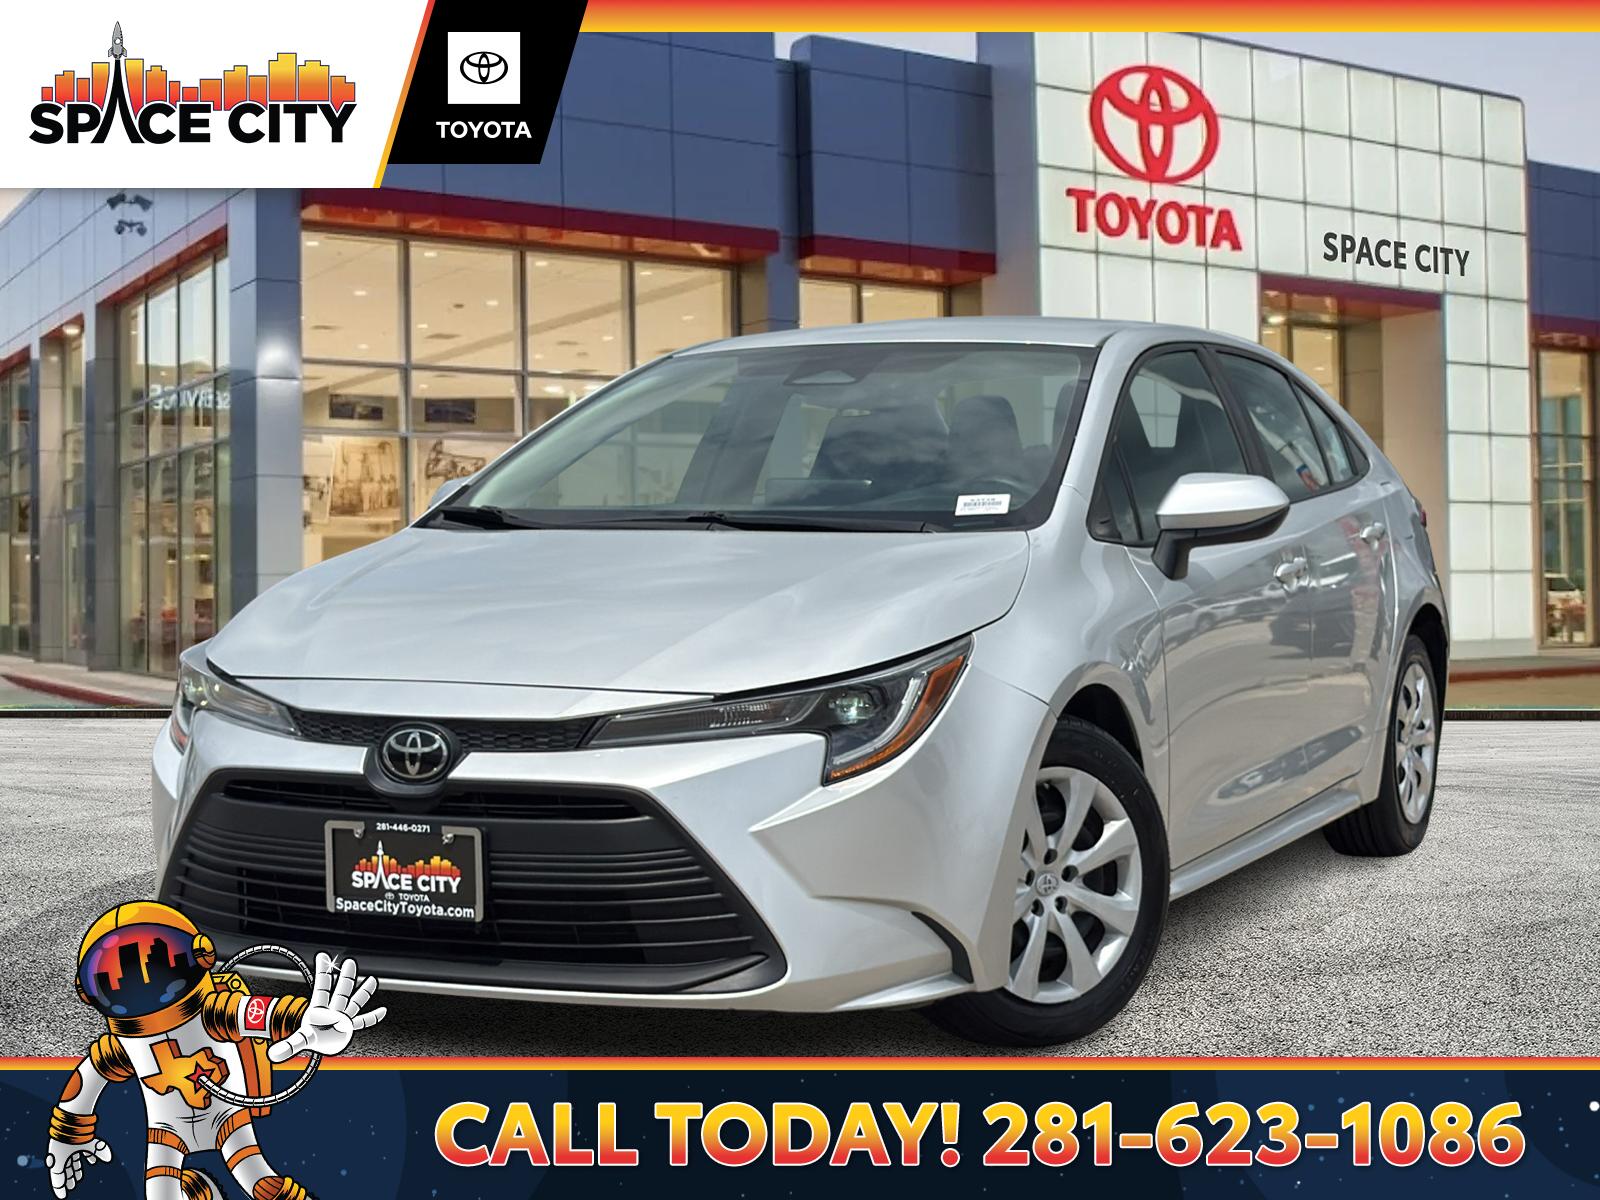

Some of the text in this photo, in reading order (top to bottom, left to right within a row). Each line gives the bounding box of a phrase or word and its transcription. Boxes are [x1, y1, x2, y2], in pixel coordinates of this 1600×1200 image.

[1066, 187, 1242, 251] TOYOTA
[1323, 231, 1470, 277] SPACE CITY
[376, 822, 431, 833] 281-446-0271
[417, 875, 461, 894] CITY
[398, 893, 430, 902] TOYOTA
[336, 897, 475, 919] SpaceCityToyota.com
